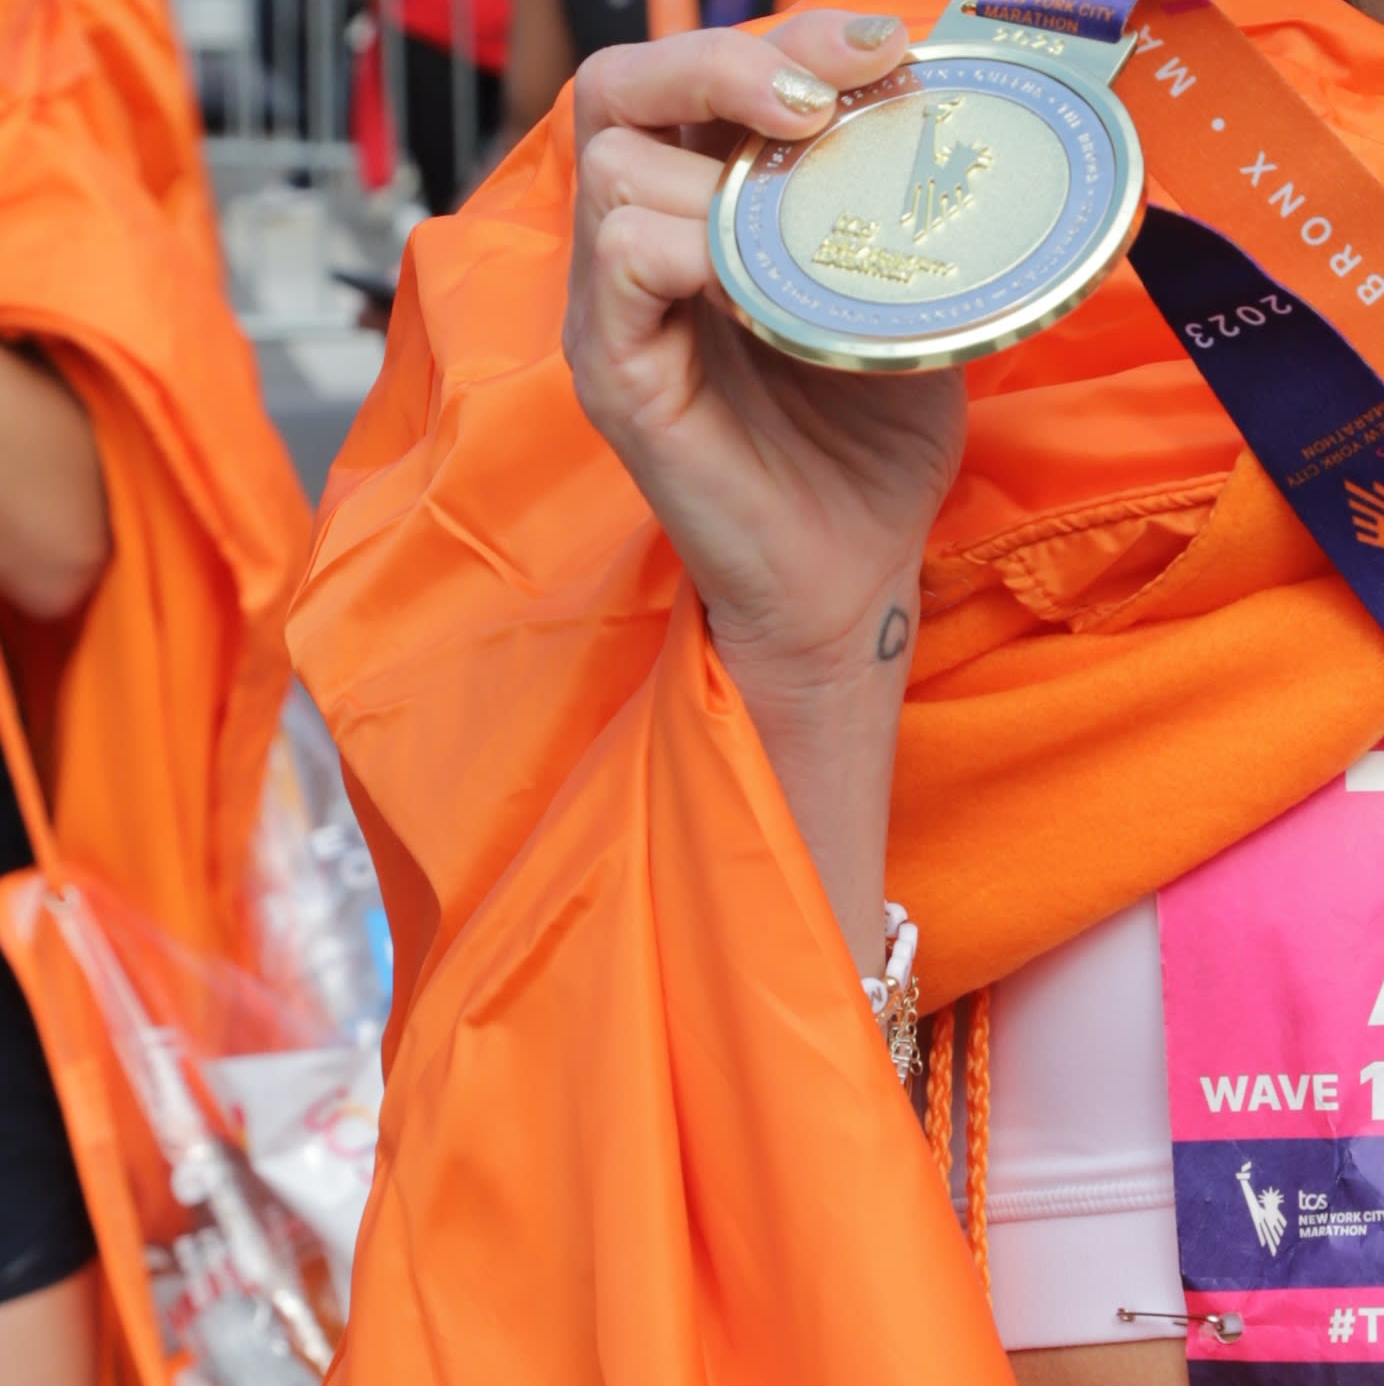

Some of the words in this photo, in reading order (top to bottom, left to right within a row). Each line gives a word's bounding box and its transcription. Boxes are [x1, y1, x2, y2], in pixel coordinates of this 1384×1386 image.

[983, 4, 1079, 33] MARATHON
[1185, 295, 1292, 348] 2023
[1200, 1074, 1339, 1113] WAVE
[1298, 1189, 1328, 1210] tcs
[1298, 1213, 1328, 1226] NEW
[1329, 1211, 1362, 1224] YORK
[1299, 1224, 1368, 1238] MARATHON
